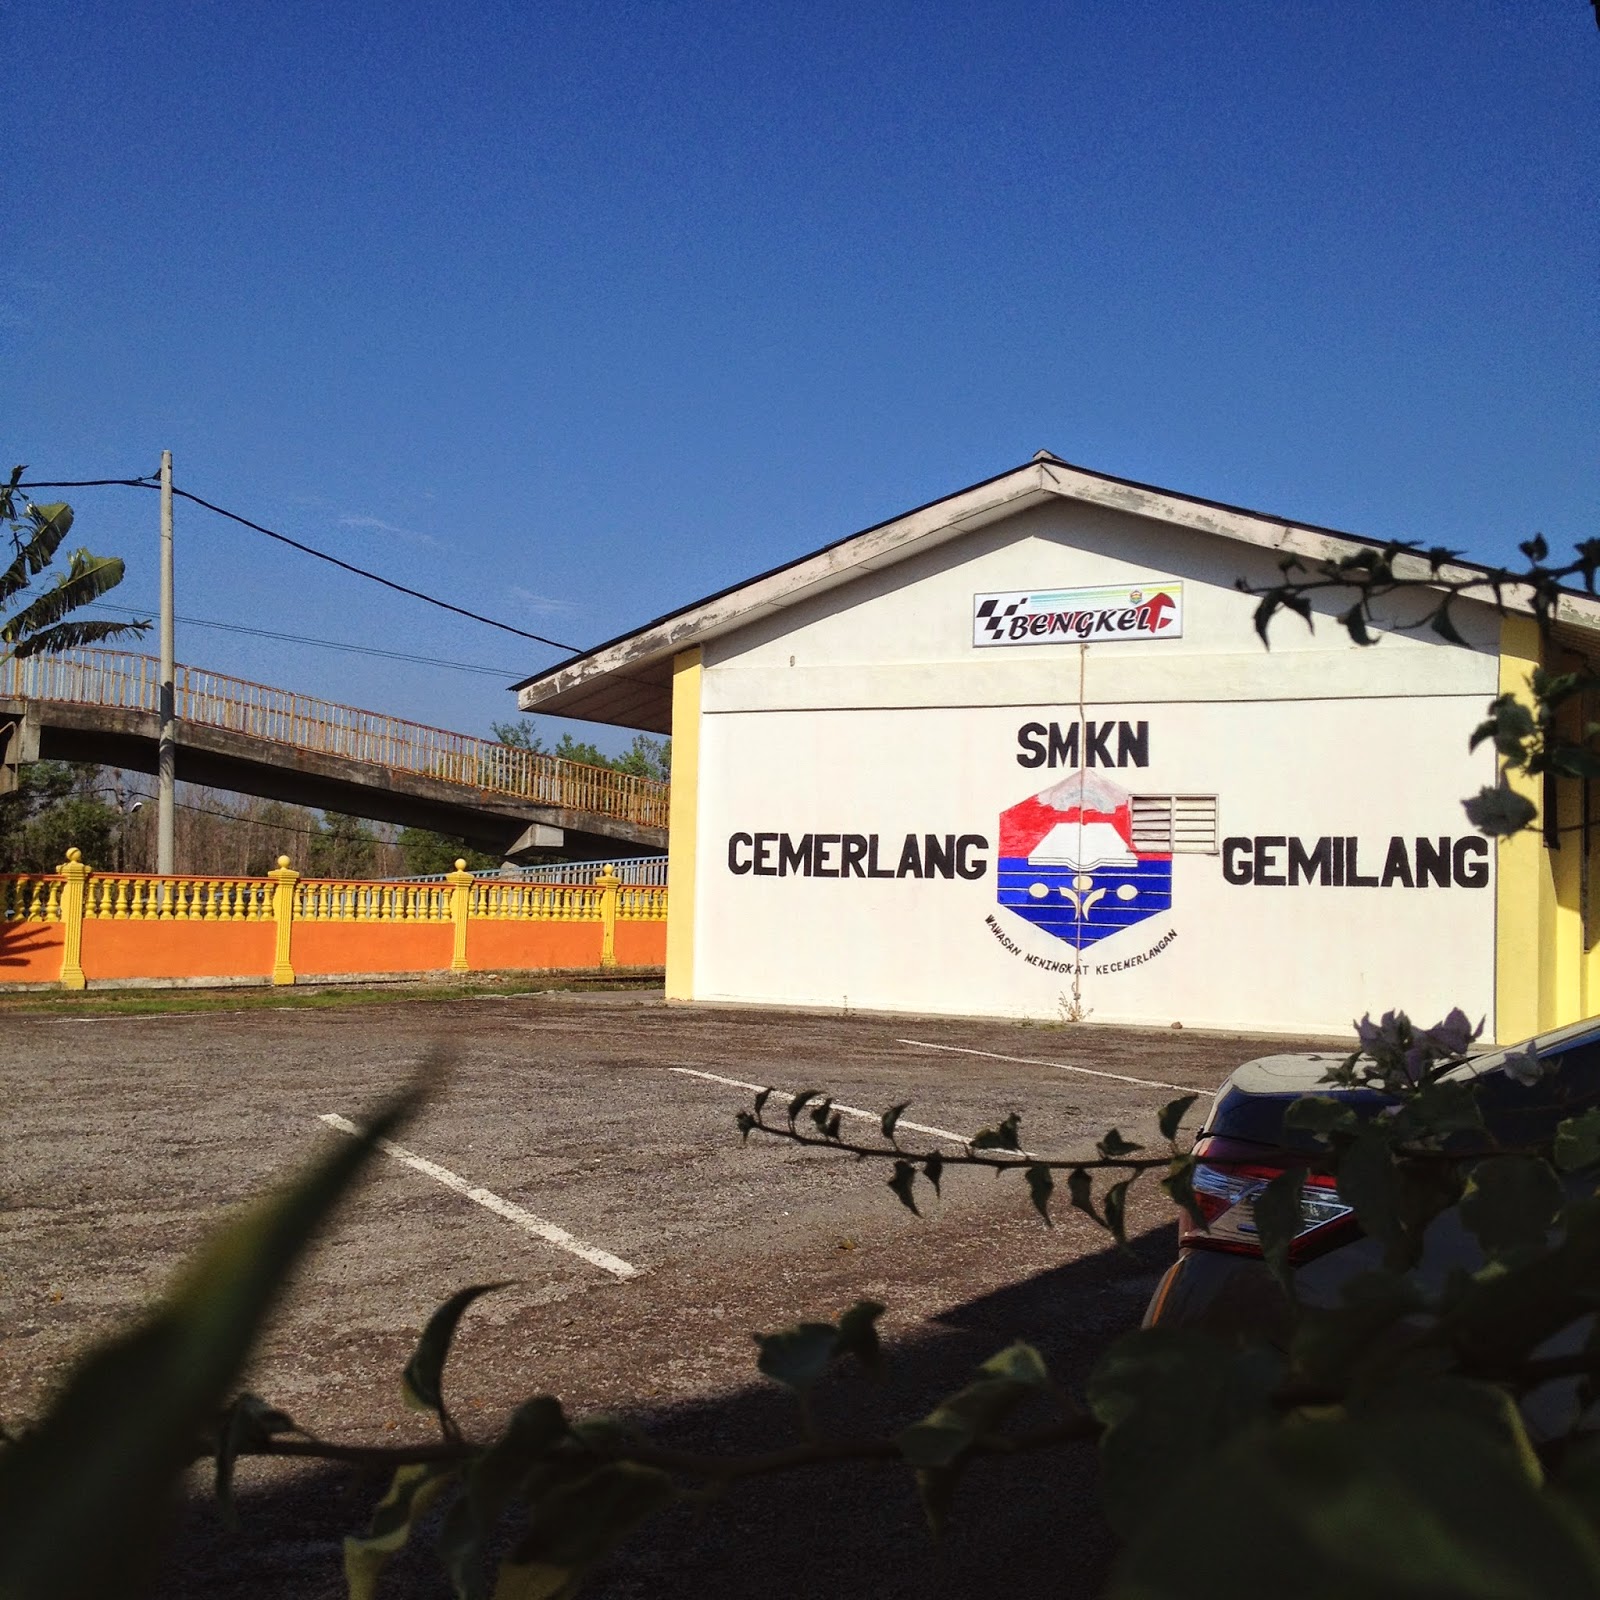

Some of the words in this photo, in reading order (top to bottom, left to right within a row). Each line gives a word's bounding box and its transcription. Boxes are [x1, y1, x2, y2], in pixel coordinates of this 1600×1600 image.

[1008, 608, 1149, 640] BENGKEL
[1017, 721, 1149, 768] SMKN
[728, 833, 989, 879] CEMERLANG
[1222, 836, 1489, 888] GEMILANG
[984, 914, 1022, 956] WAWASAN
[1024, 953, 1090, 975] MENINGKAT
[1095, 928, 1178, 975] KECEMERLANGAN
